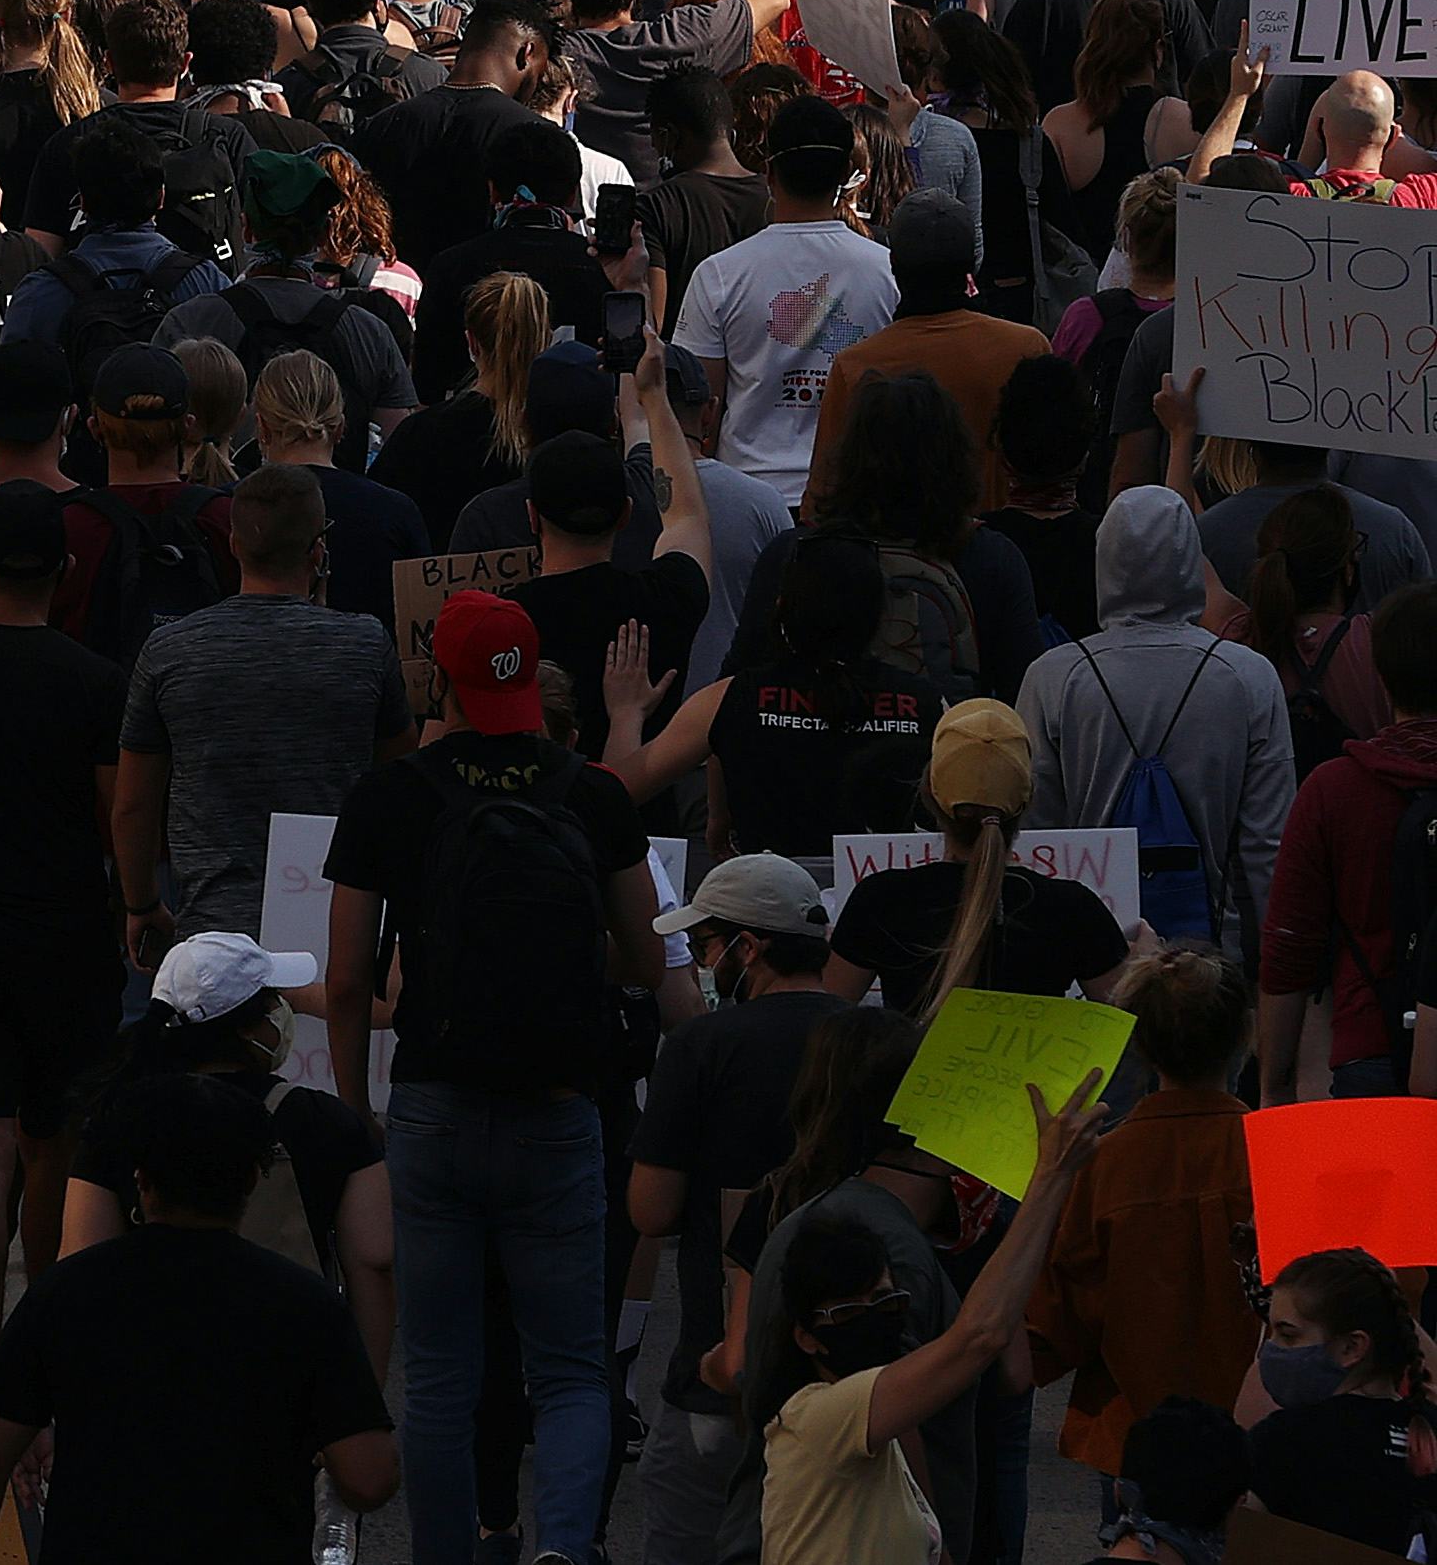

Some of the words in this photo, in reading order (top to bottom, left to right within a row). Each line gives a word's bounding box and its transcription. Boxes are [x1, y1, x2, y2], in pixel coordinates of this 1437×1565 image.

[1195, 276, 1437, 384] Killing
[1236, 352, 1413, 434] Black
[422, 551, 543, 586] BLACK
